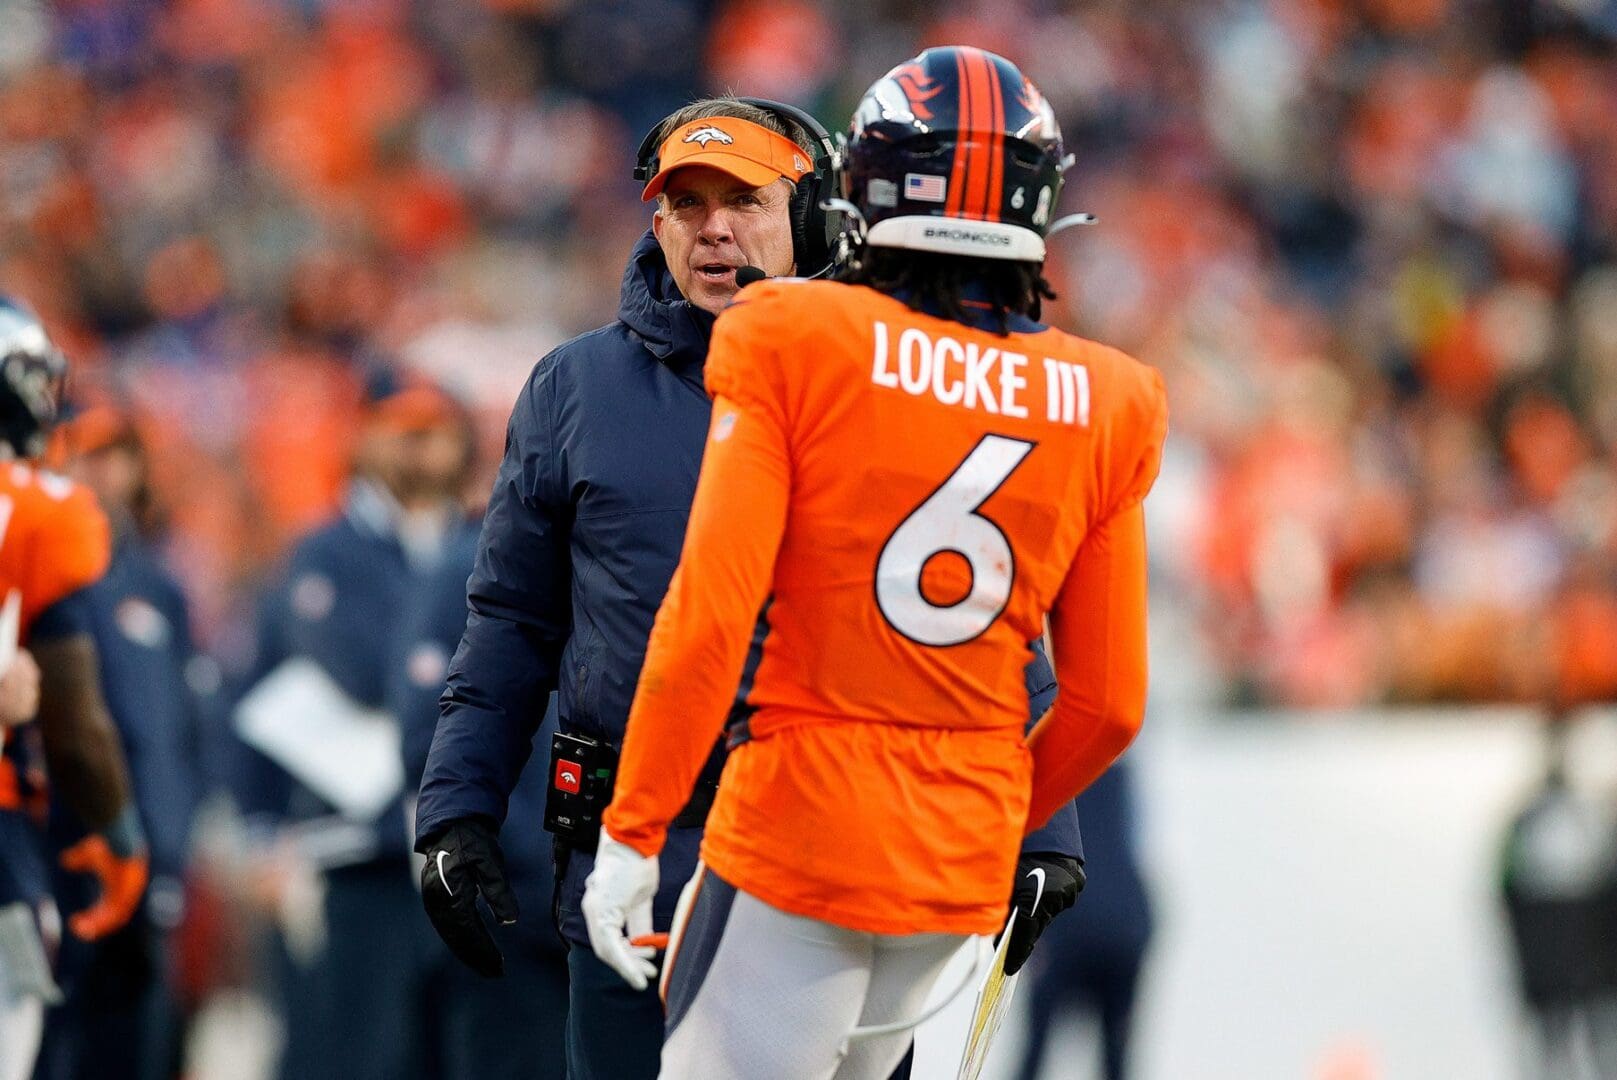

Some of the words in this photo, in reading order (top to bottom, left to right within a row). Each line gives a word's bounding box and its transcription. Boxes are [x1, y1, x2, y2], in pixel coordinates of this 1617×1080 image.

[1011, 186, 1024, 209] 6
[924, 228, 1009, 245] BRONCOS
[872, 321, 1028, 418] LOCKE
[1043, 357, 1090, 427] III
[873, 432, 1039, 647] 6
